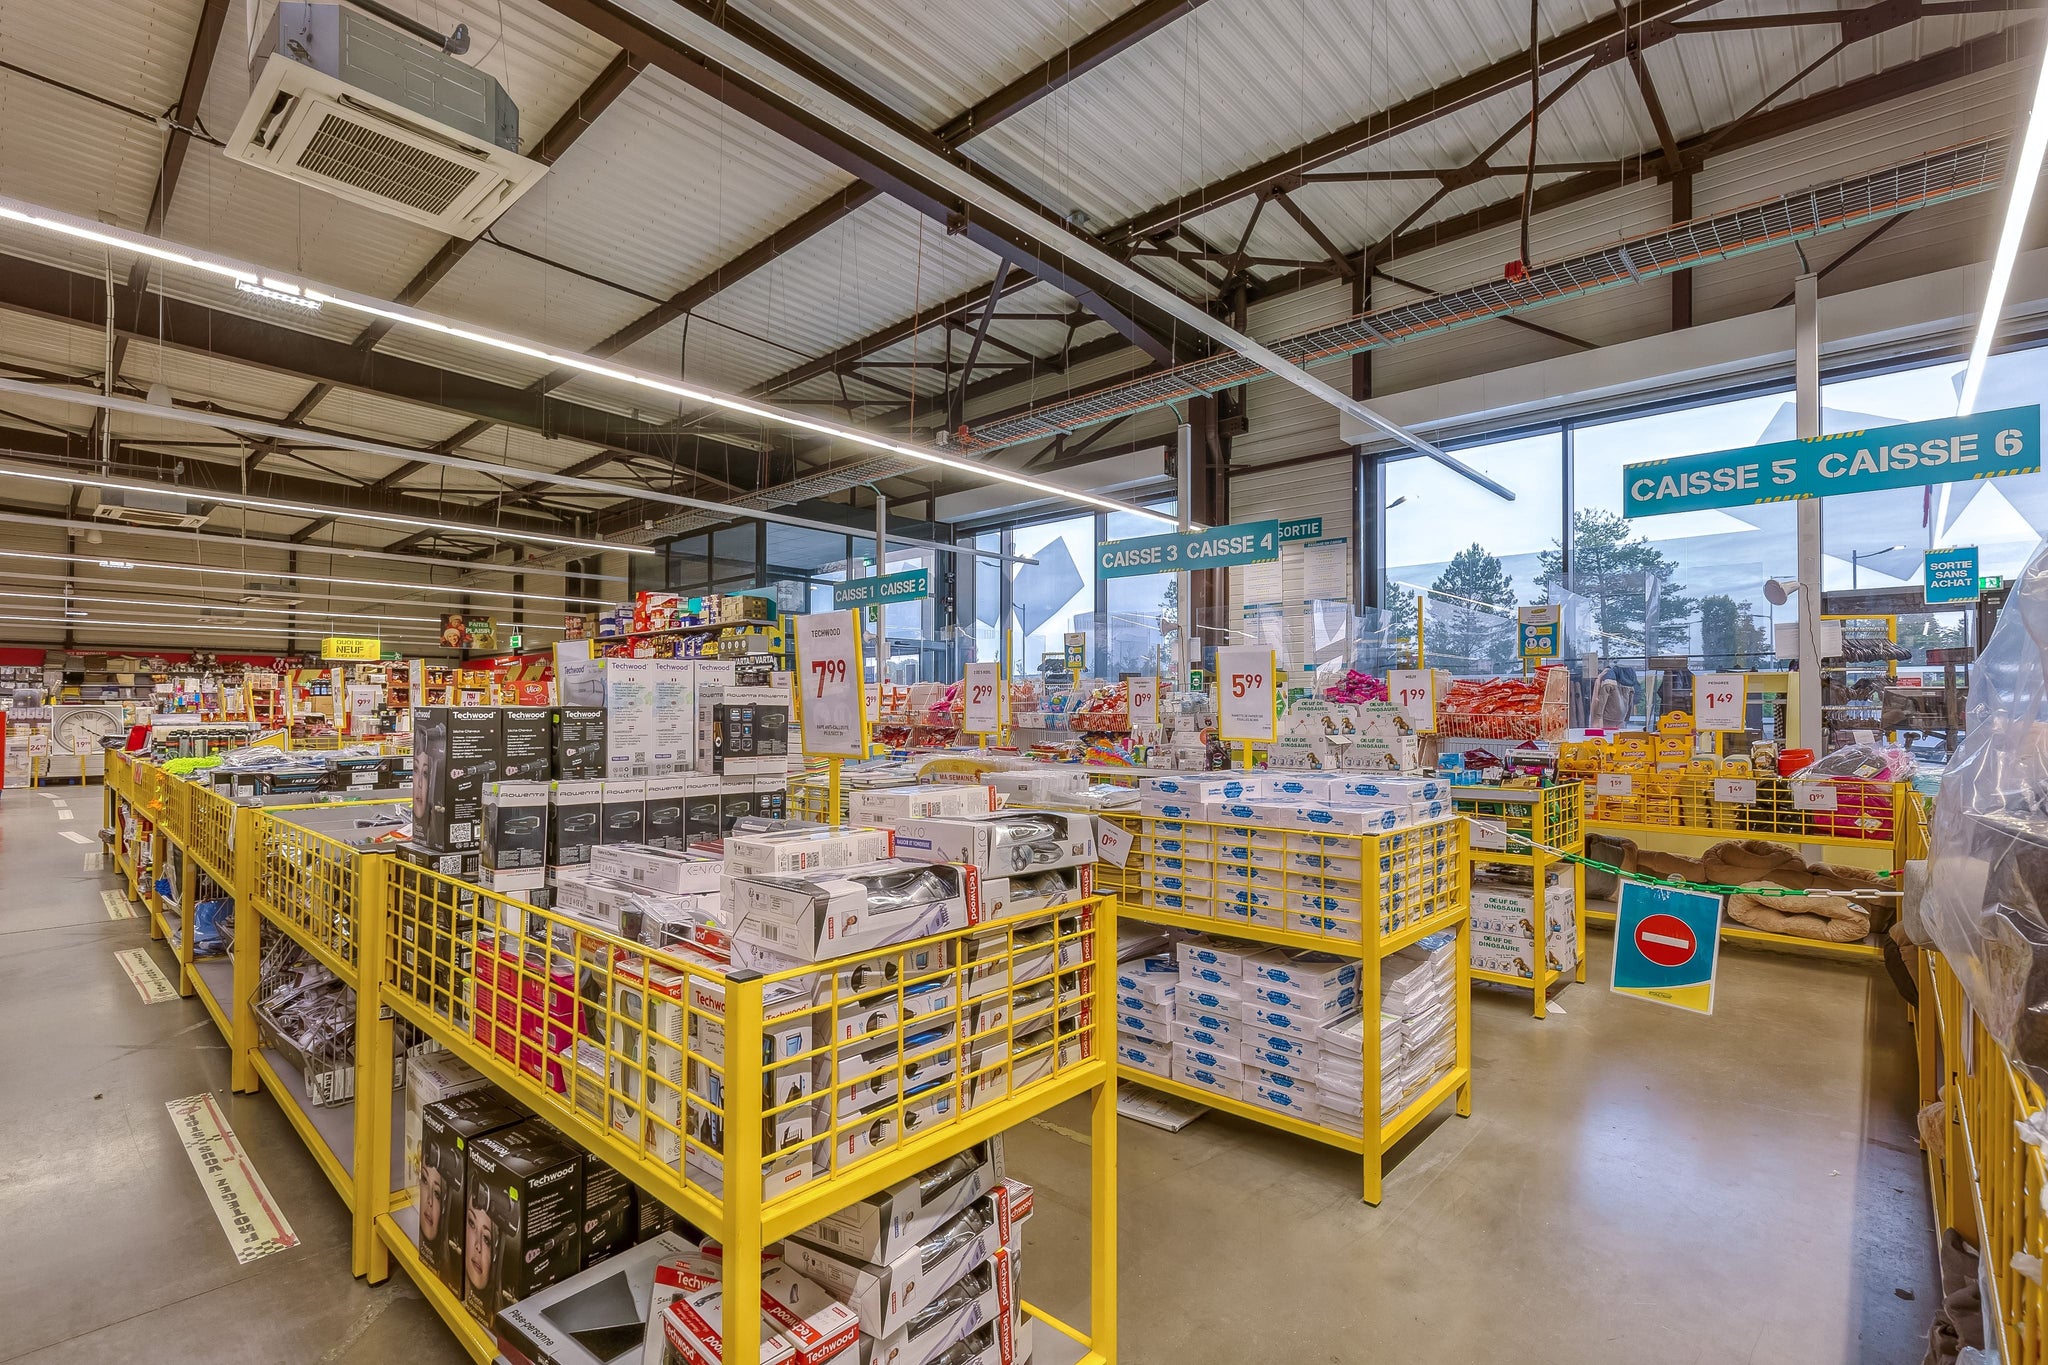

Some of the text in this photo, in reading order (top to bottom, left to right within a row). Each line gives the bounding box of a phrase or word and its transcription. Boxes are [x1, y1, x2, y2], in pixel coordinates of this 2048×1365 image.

[1817, 428, 2024, 479] CAISSE 6
[1630, 458, 1797, 501] CAISSE 5
[1278, 523, 1319, 538] SORTIE
[1187, 532, 1273, 559] CAISSE 4
[1102, 544, 1178, 569] CAISSE 3
[1930, 560, 1973, 571] SORTIE
[1935, 570, 1968, 580] SANS
[880, 578, 926, 596] CAISSE 2
[1930, 577, 1973, 589] ACHAT
[835, 585, 875, 602] CAISSE 1
[812, 628, 841, 638] TECHWOOD
[336, 646, 364, 654] NEUF
[754, 655, 777, 664] VARTA
[564, 666, 585, 677] Techwood
[612, 662, 647, 670] Techwood
[656, 663, 689, 671] Techwood
[699, 663, 730, 671] Techwood
[453, 711, 493, 720] Techwood
[507, 711, 544, 719] Techwood
[565, 710, 602, 718] Techwood
[950, 774, 974, 782] SEMAINE
[968, 869, 978, 921] Techwood
[1484, 903, 1526, 913] DINOSAURE
[1478, 941, 1520, 952] DINOSAURE
[696, 991, 726, 1012] Techwo
[469, 1146, 496, 1173] Techwood
[528, 1164, 575, 1187] Techwood
[508, 1308, 555, 1347] Pèse-personne
[767, 1307, 814, 1341] Techwood
[806, 1328, 855, 1362] Techwood
